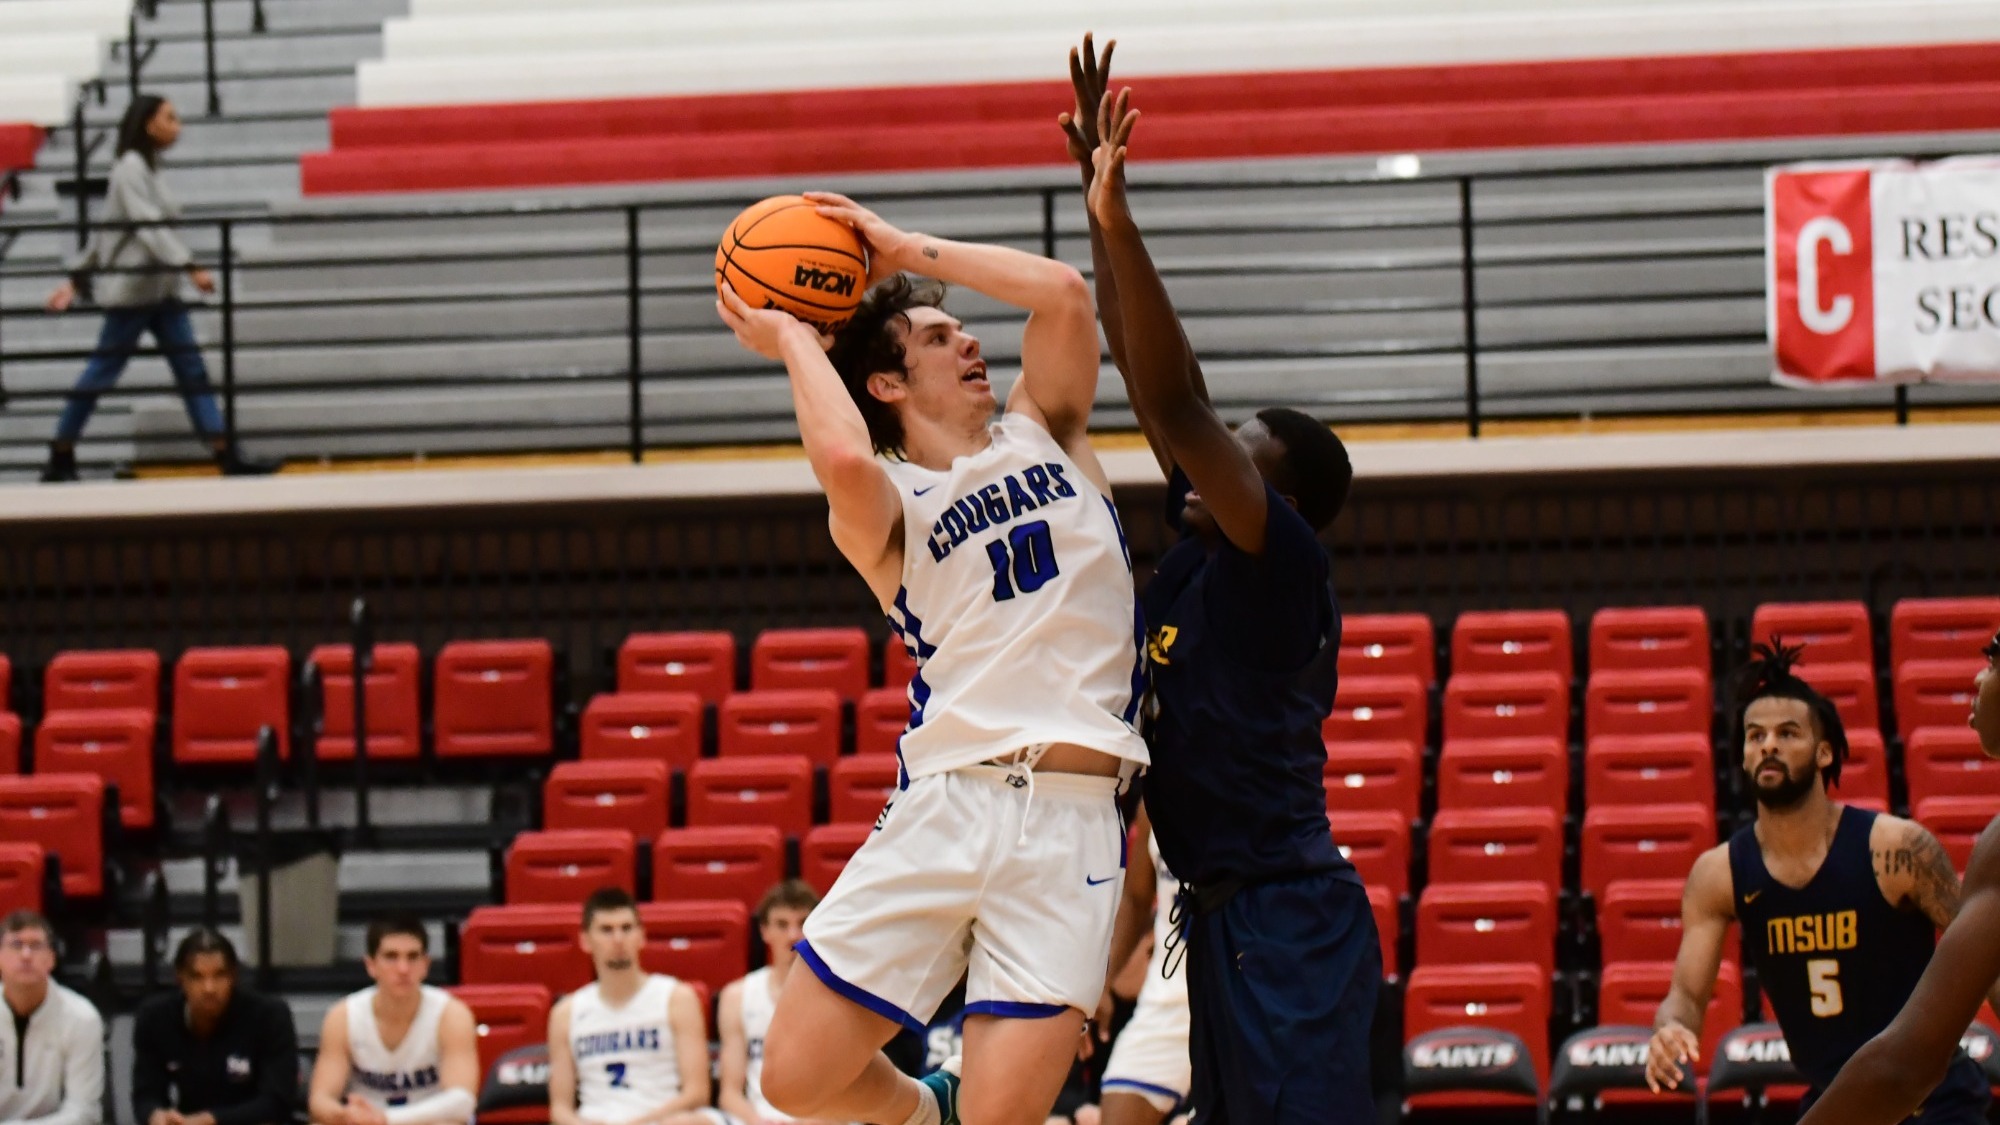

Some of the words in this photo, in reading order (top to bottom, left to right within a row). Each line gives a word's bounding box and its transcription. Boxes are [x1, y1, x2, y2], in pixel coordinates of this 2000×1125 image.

[1900, 212, 2000, 261] RES
[794, 265, 856, 297] NCAA
[1796, 216, 1854, 335] C
[927, 462, 1077, 563] COUGARS
[985, 519, 1060, 602] 10
[1767, 909, 1858, 955] MSUB
[1807, 959, 1844, 1018] 5
[1412, 1042, 1516, 1068] SAINTS
